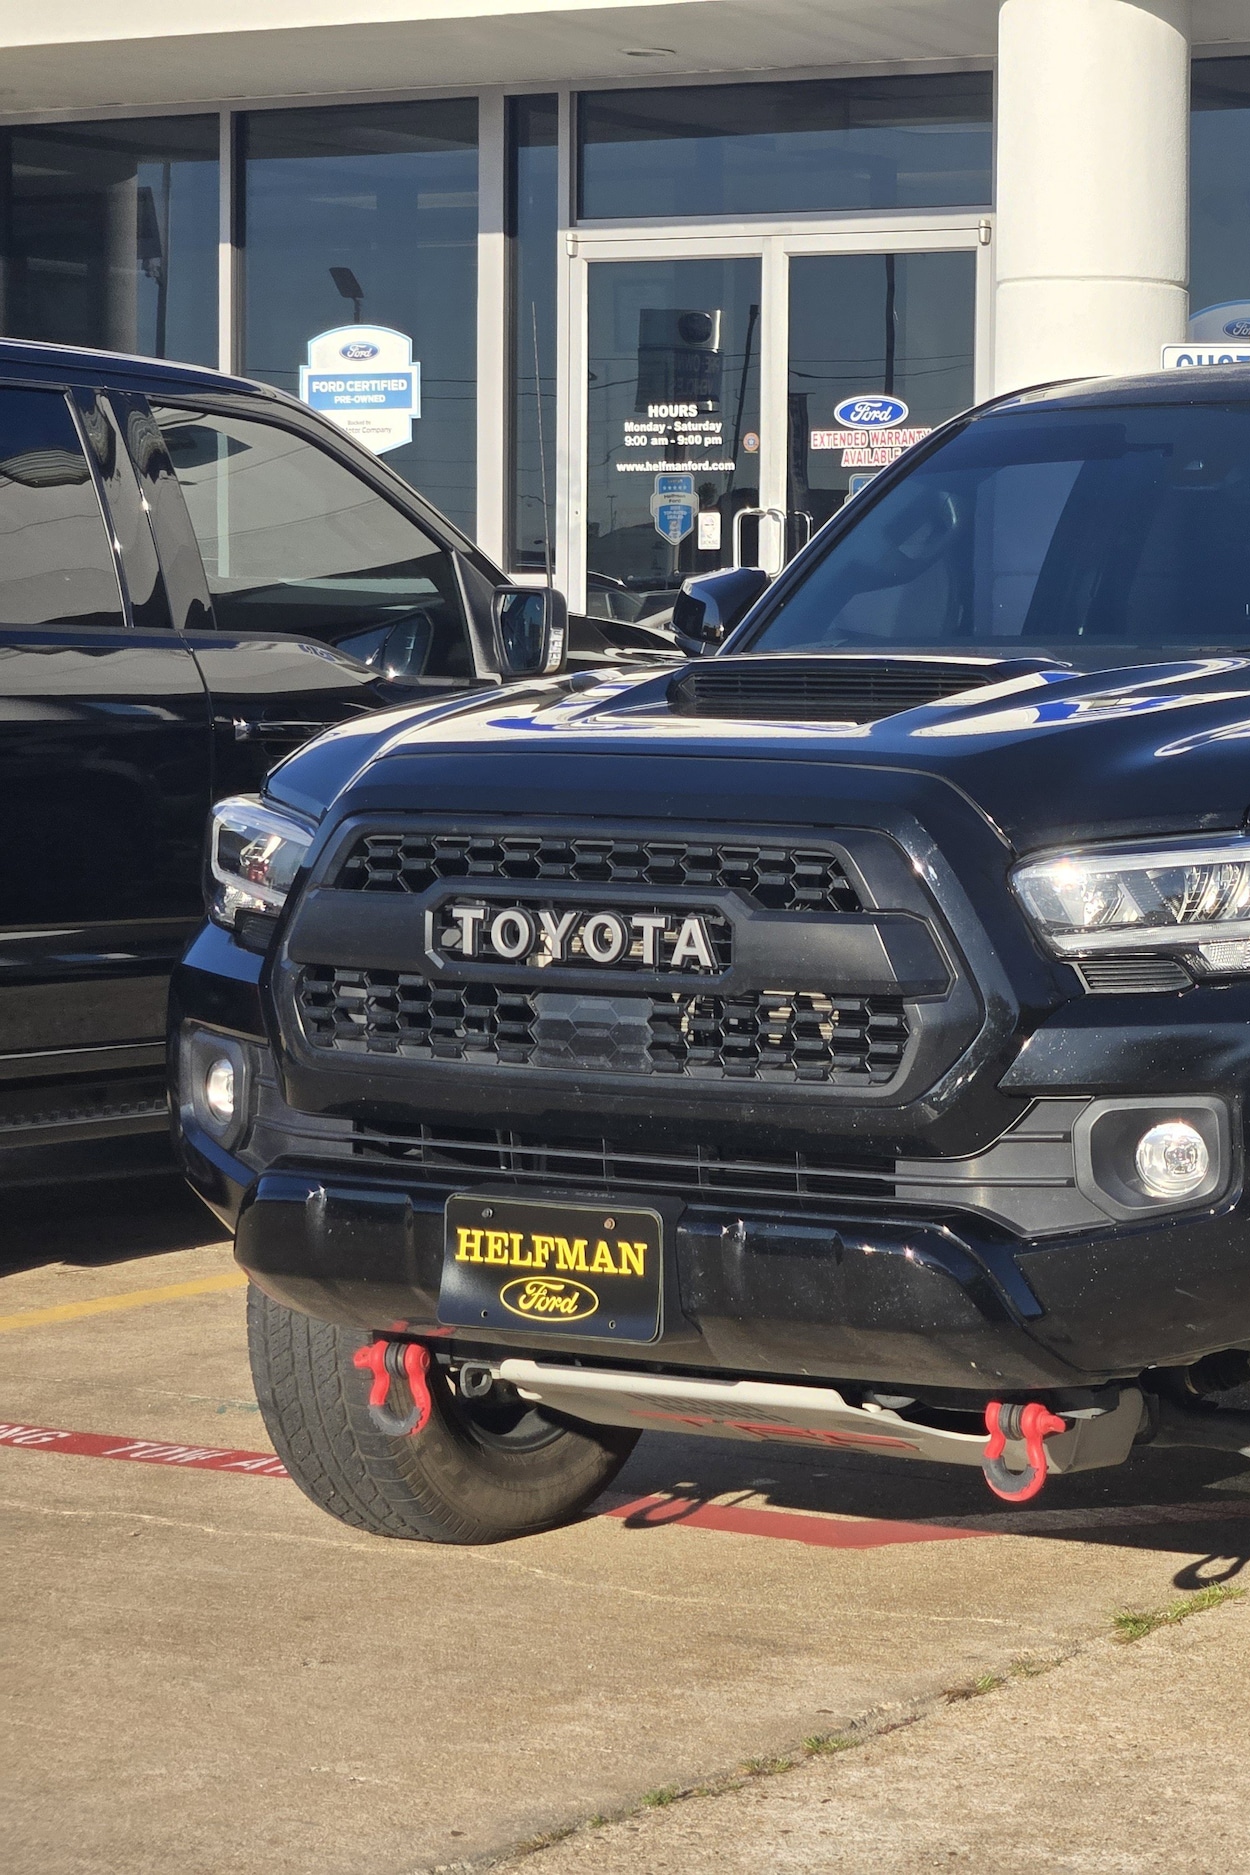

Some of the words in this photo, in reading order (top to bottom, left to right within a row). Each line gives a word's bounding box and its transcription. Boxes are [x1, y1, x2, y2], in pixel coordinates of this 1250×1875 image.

[347, 344, 372, 358] Ford
[312, 381, 345, 393] FORD
[346, 379, 408, 392] CERTIFIED
[334, 394, 386, 404] PRE-OWNED
[648, 404, 698, 418] HOURS
[850, 401, 893, 422] Ford
[624, 421, 666, 434] Monday
[674, 420, 723, 433] Saturday
[624, 435, 648, 446] 9:00
[650, 437, 669, 446] am
[677, 434, 702, 446] 9:00
[704, 436, 723, 447] pm
[812, 431, 868, 448] EXTENDED
[842, 449, 901, 466] AVAILABLE
[616, 460, 736, 471] www.helfmanford.com
[452, 905, 716, 968] TOYOTA
[455, 1227, 648, 1276] HELFMAN
[518, 1280, 581, 1314] Ford
